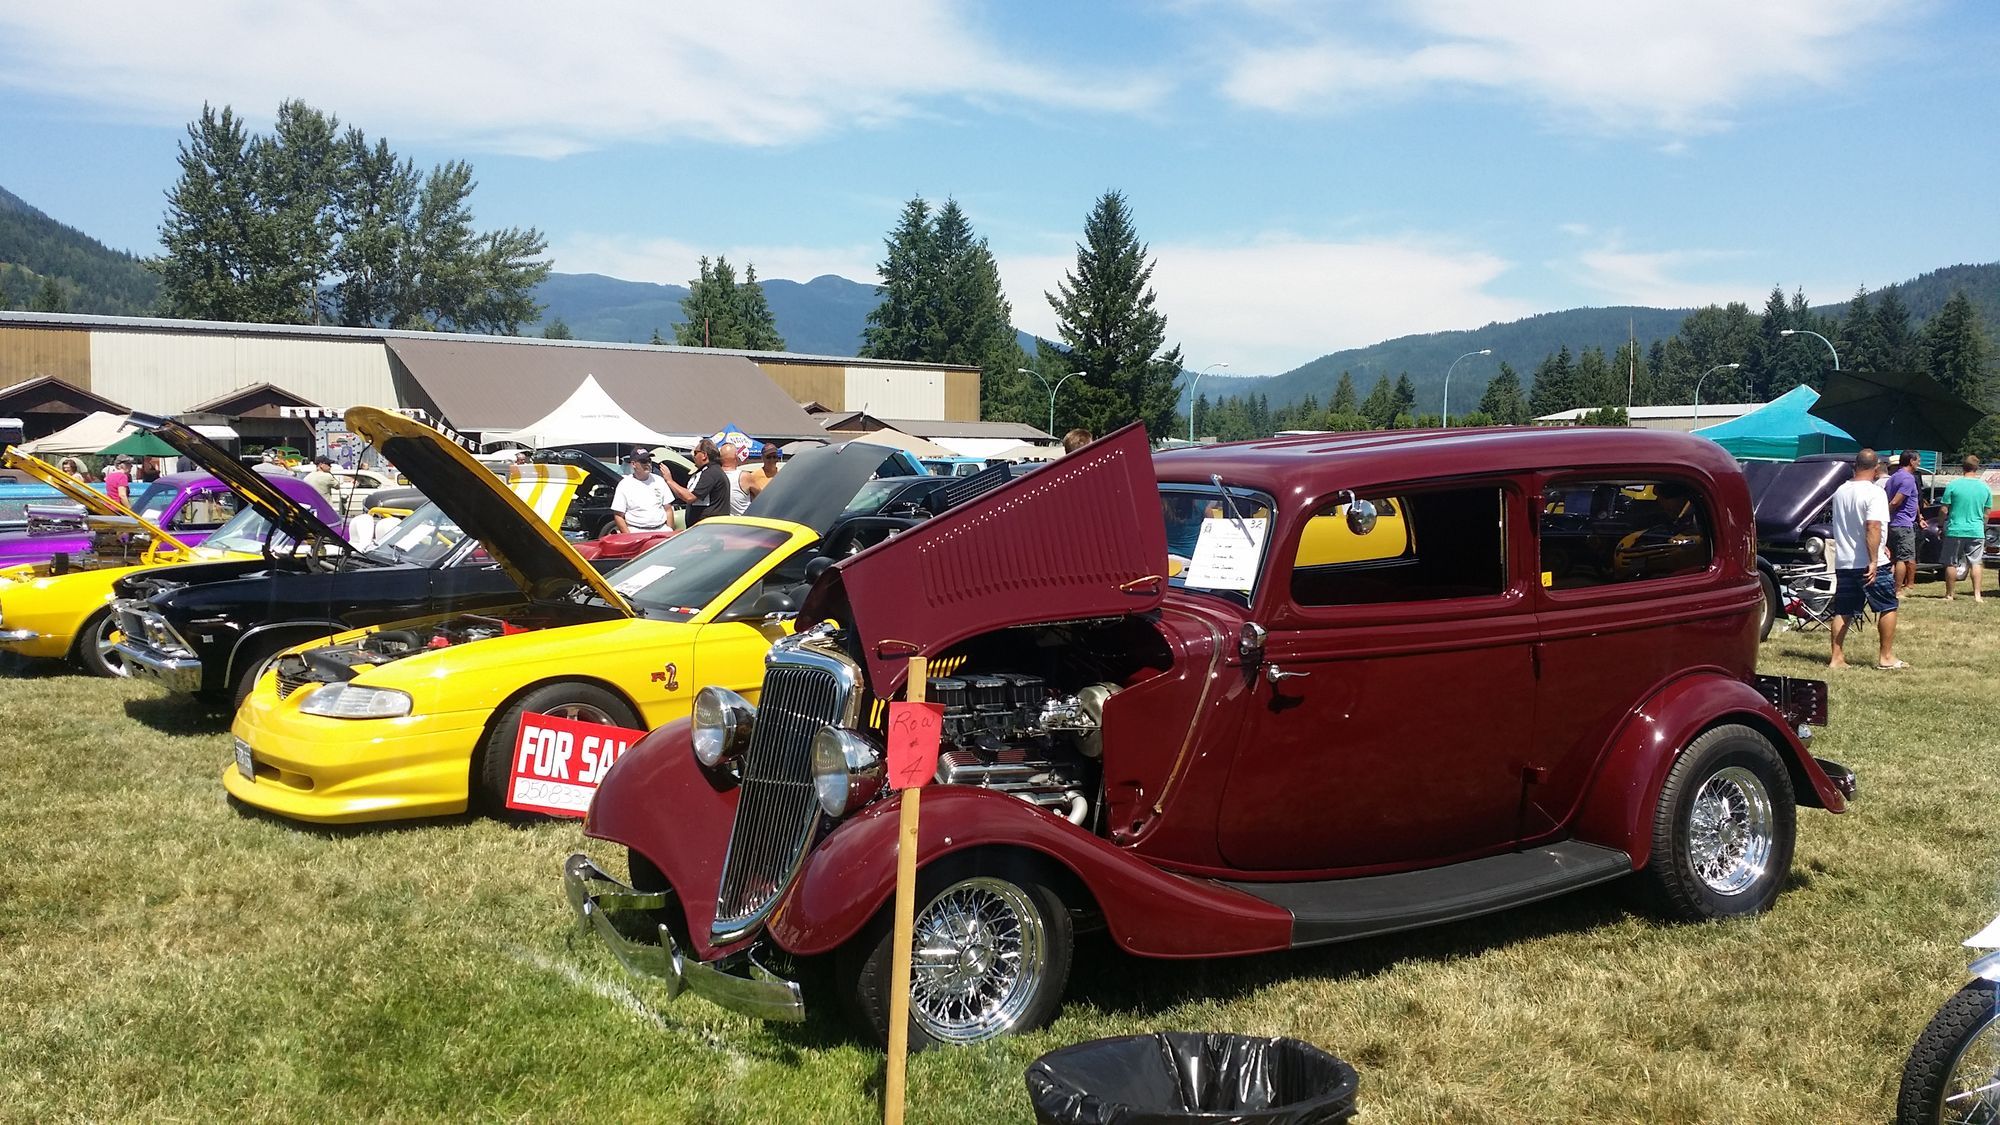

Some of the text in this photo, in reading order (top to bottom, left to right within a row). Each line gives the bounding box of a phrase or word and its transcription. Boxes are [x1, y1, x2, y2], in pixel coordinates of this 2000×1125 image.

[893, 710, 936, 735] Row
[517, 725, 627, 784] FOR SA
[900, 755, 924, 785] 4
